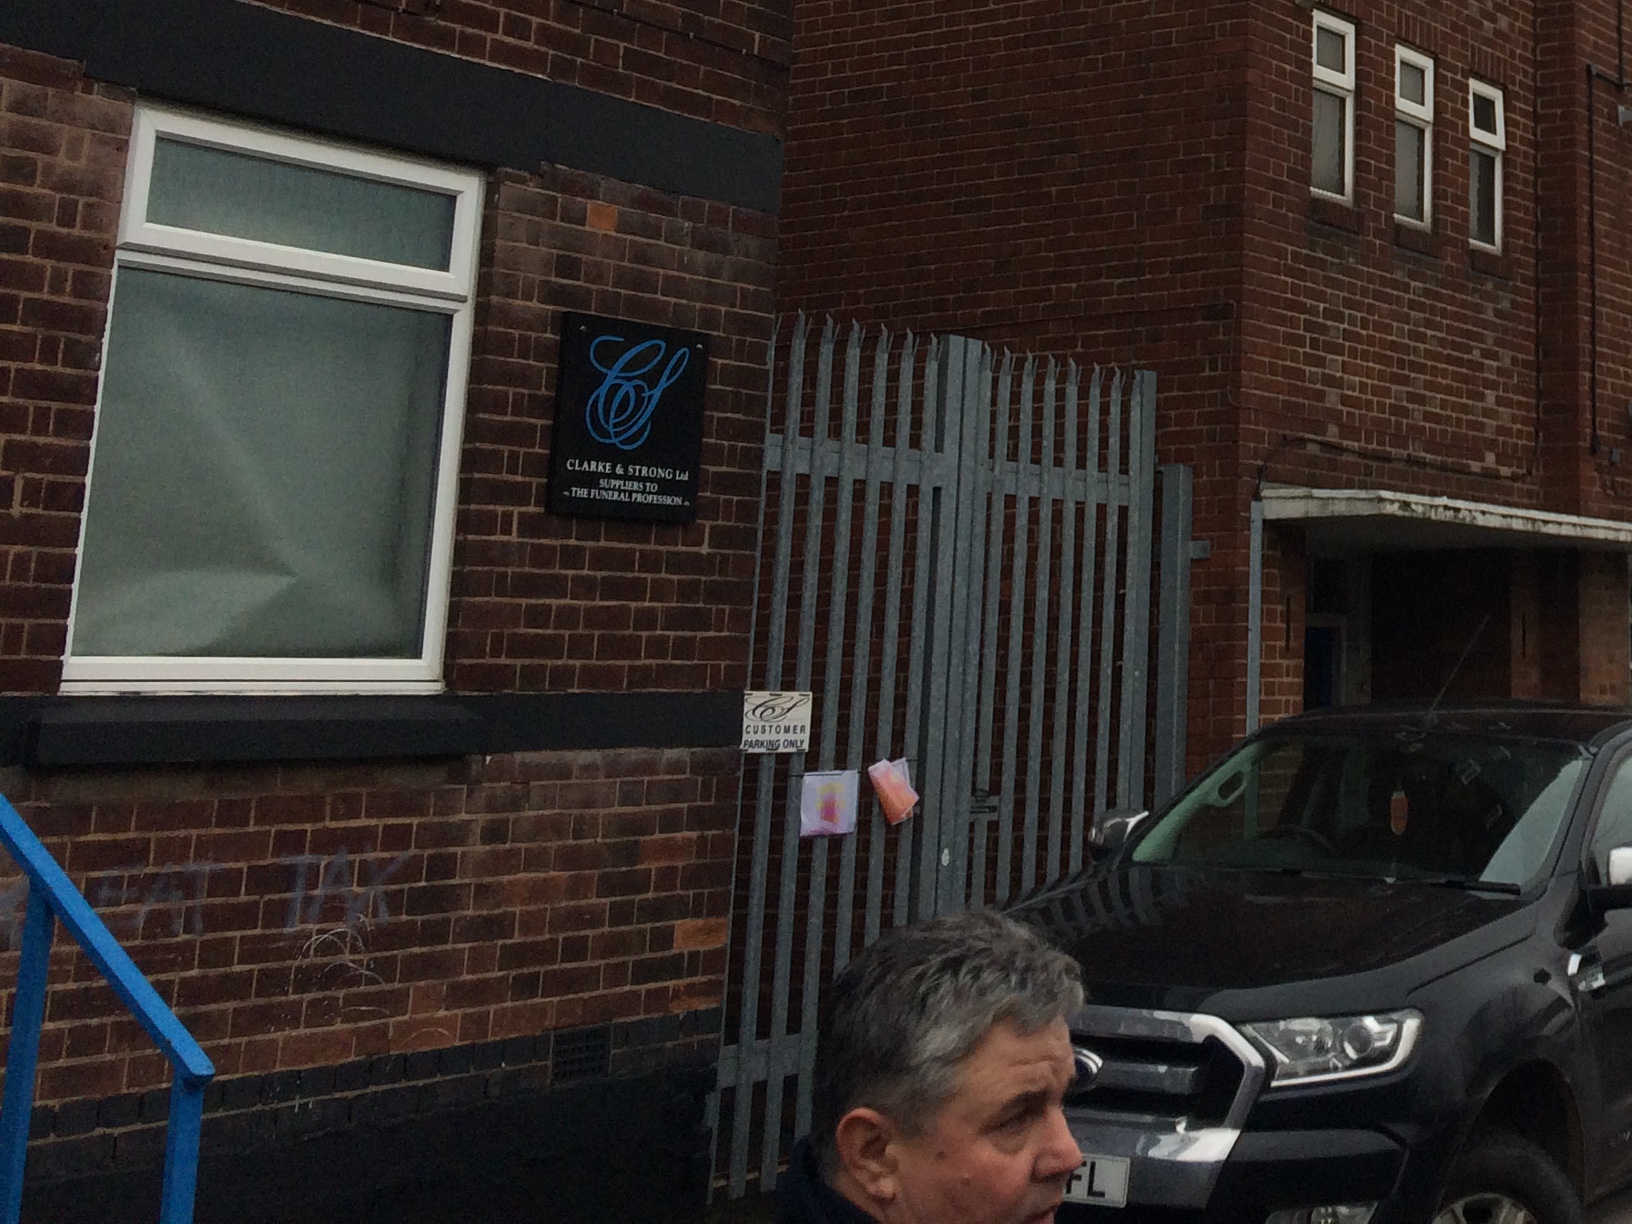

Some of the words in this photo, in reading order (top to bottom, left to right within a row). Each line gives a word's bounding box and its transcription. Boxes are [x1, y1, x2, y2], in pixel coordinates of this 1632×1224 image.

[566, 458, 612, 474] CLARKE
[615, 463, 625, 475] &
[628, 464, 674, 480] STRONG
[599, 478, 644, 492] SUPPLIERS
[645, 482, 658, 493] TO
[571, 487, 589, 499] THE
[590, 488, 630, 502] FUNERAL
[631, 492, 682, 506] PROFESSION
[745, 724, 806, 735] CUSTOMER
[743, 738, 780, 749] PARKING
[782, 738, 805, 749] ONLY
